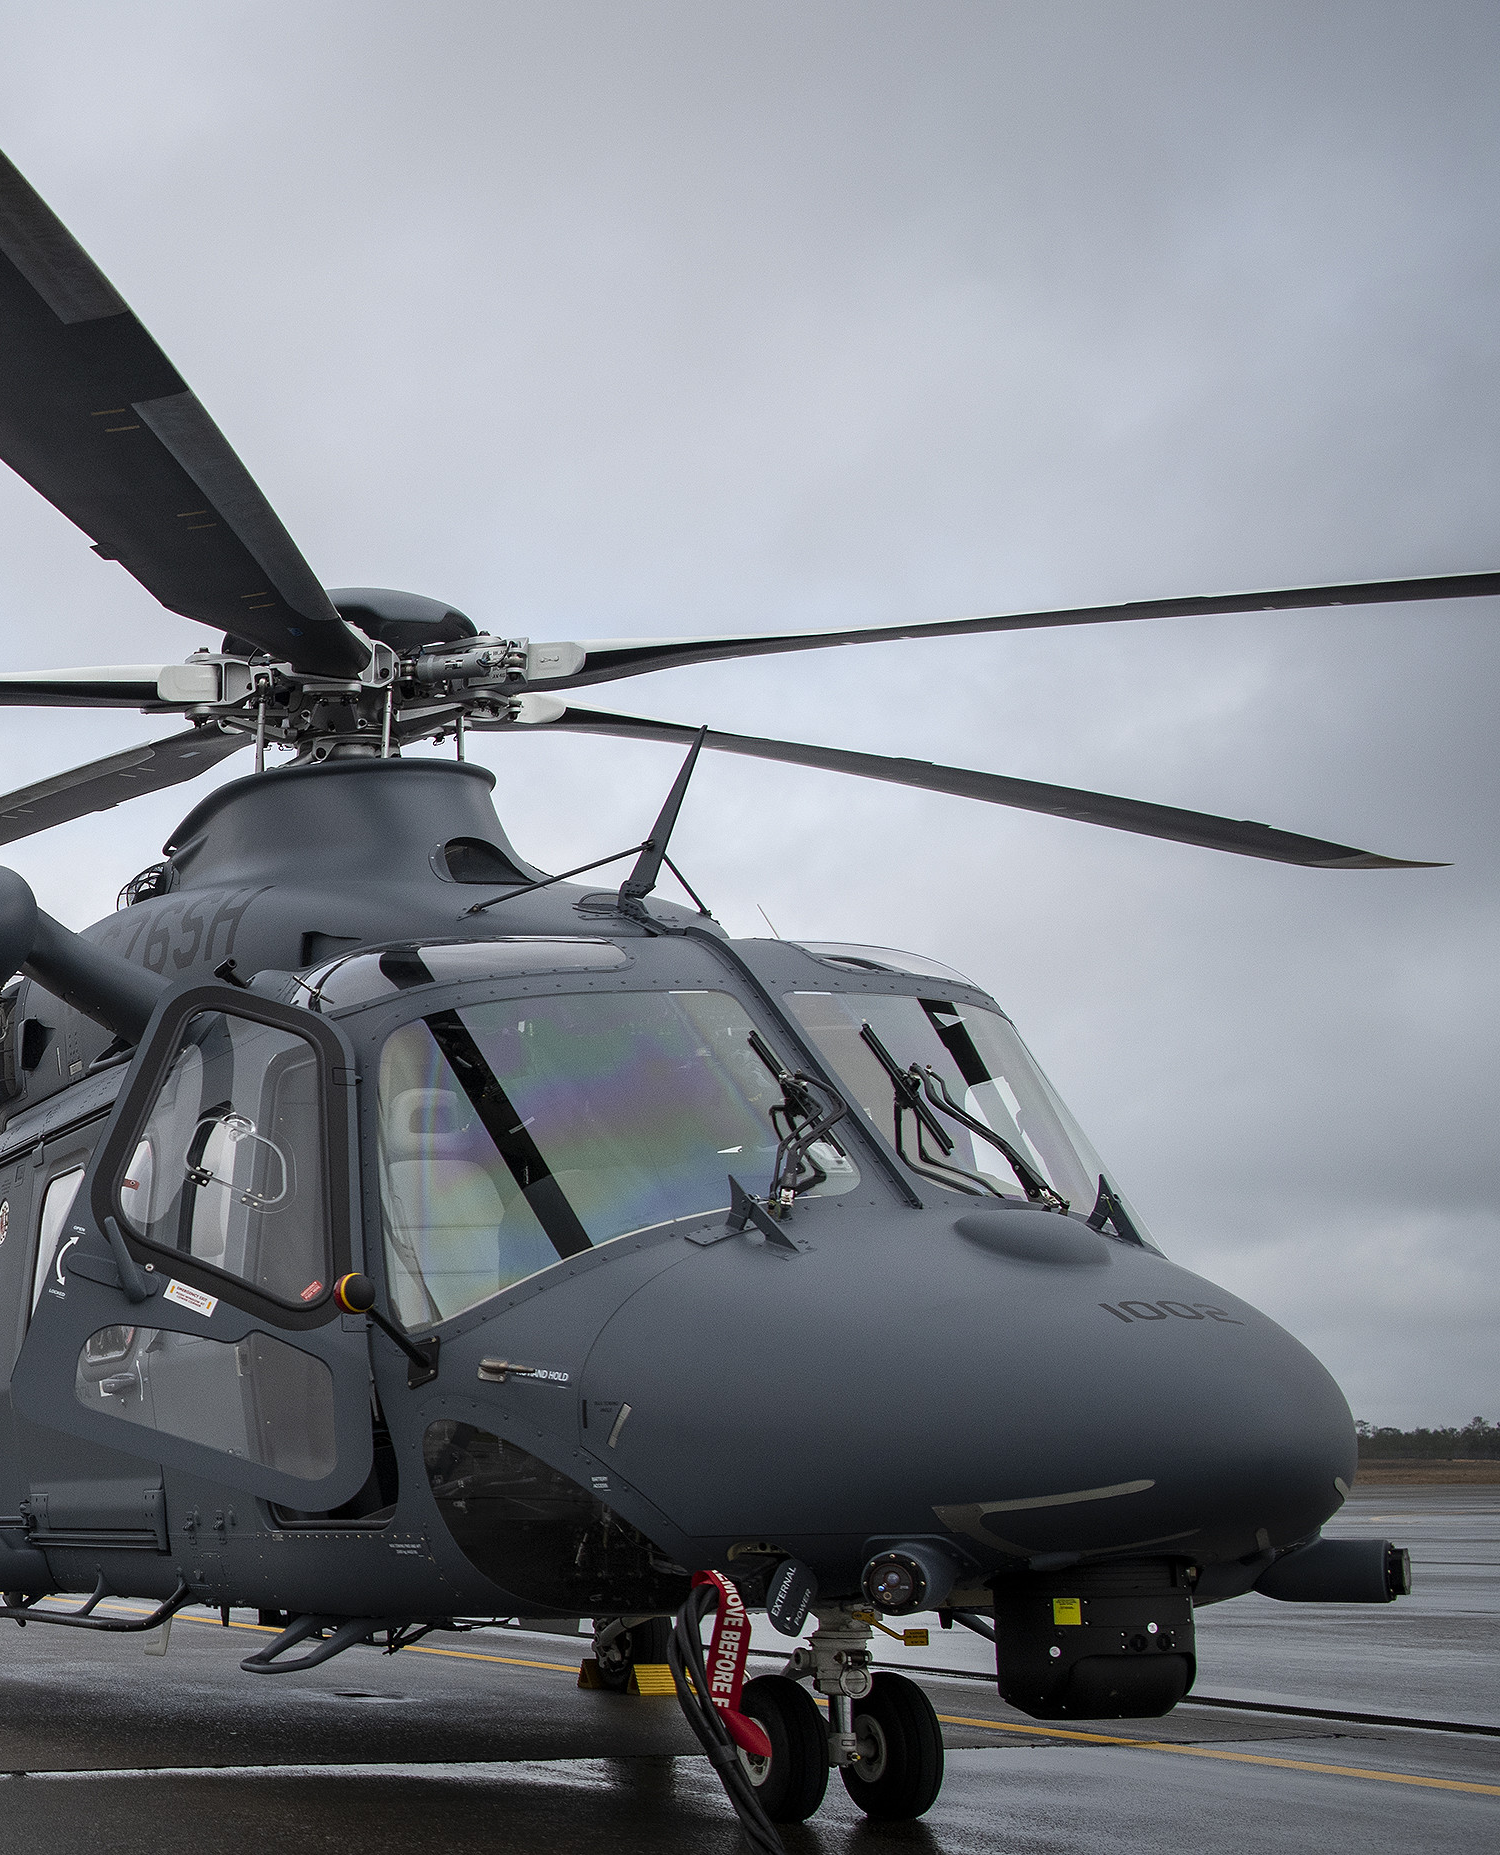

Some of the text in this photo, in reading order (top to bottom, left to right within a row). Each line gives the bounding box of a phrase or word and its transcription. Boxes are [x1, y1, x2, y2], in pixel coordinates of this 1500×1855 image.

[48, 1288, 66, 1296] LOCKED
[176, 1286, 199, 1298] EMERGENCY
[1098, 1301, 1245, 1325] 1002
[548, 1371, 569, 1381] HOLD
[770, 1566, 797, 1617] EXTERNAL
[793, 1588, 812, 1626] POWER
[711, 1630, 742, 1694] BEFORE
[711, 1696, 730, 1708] F
